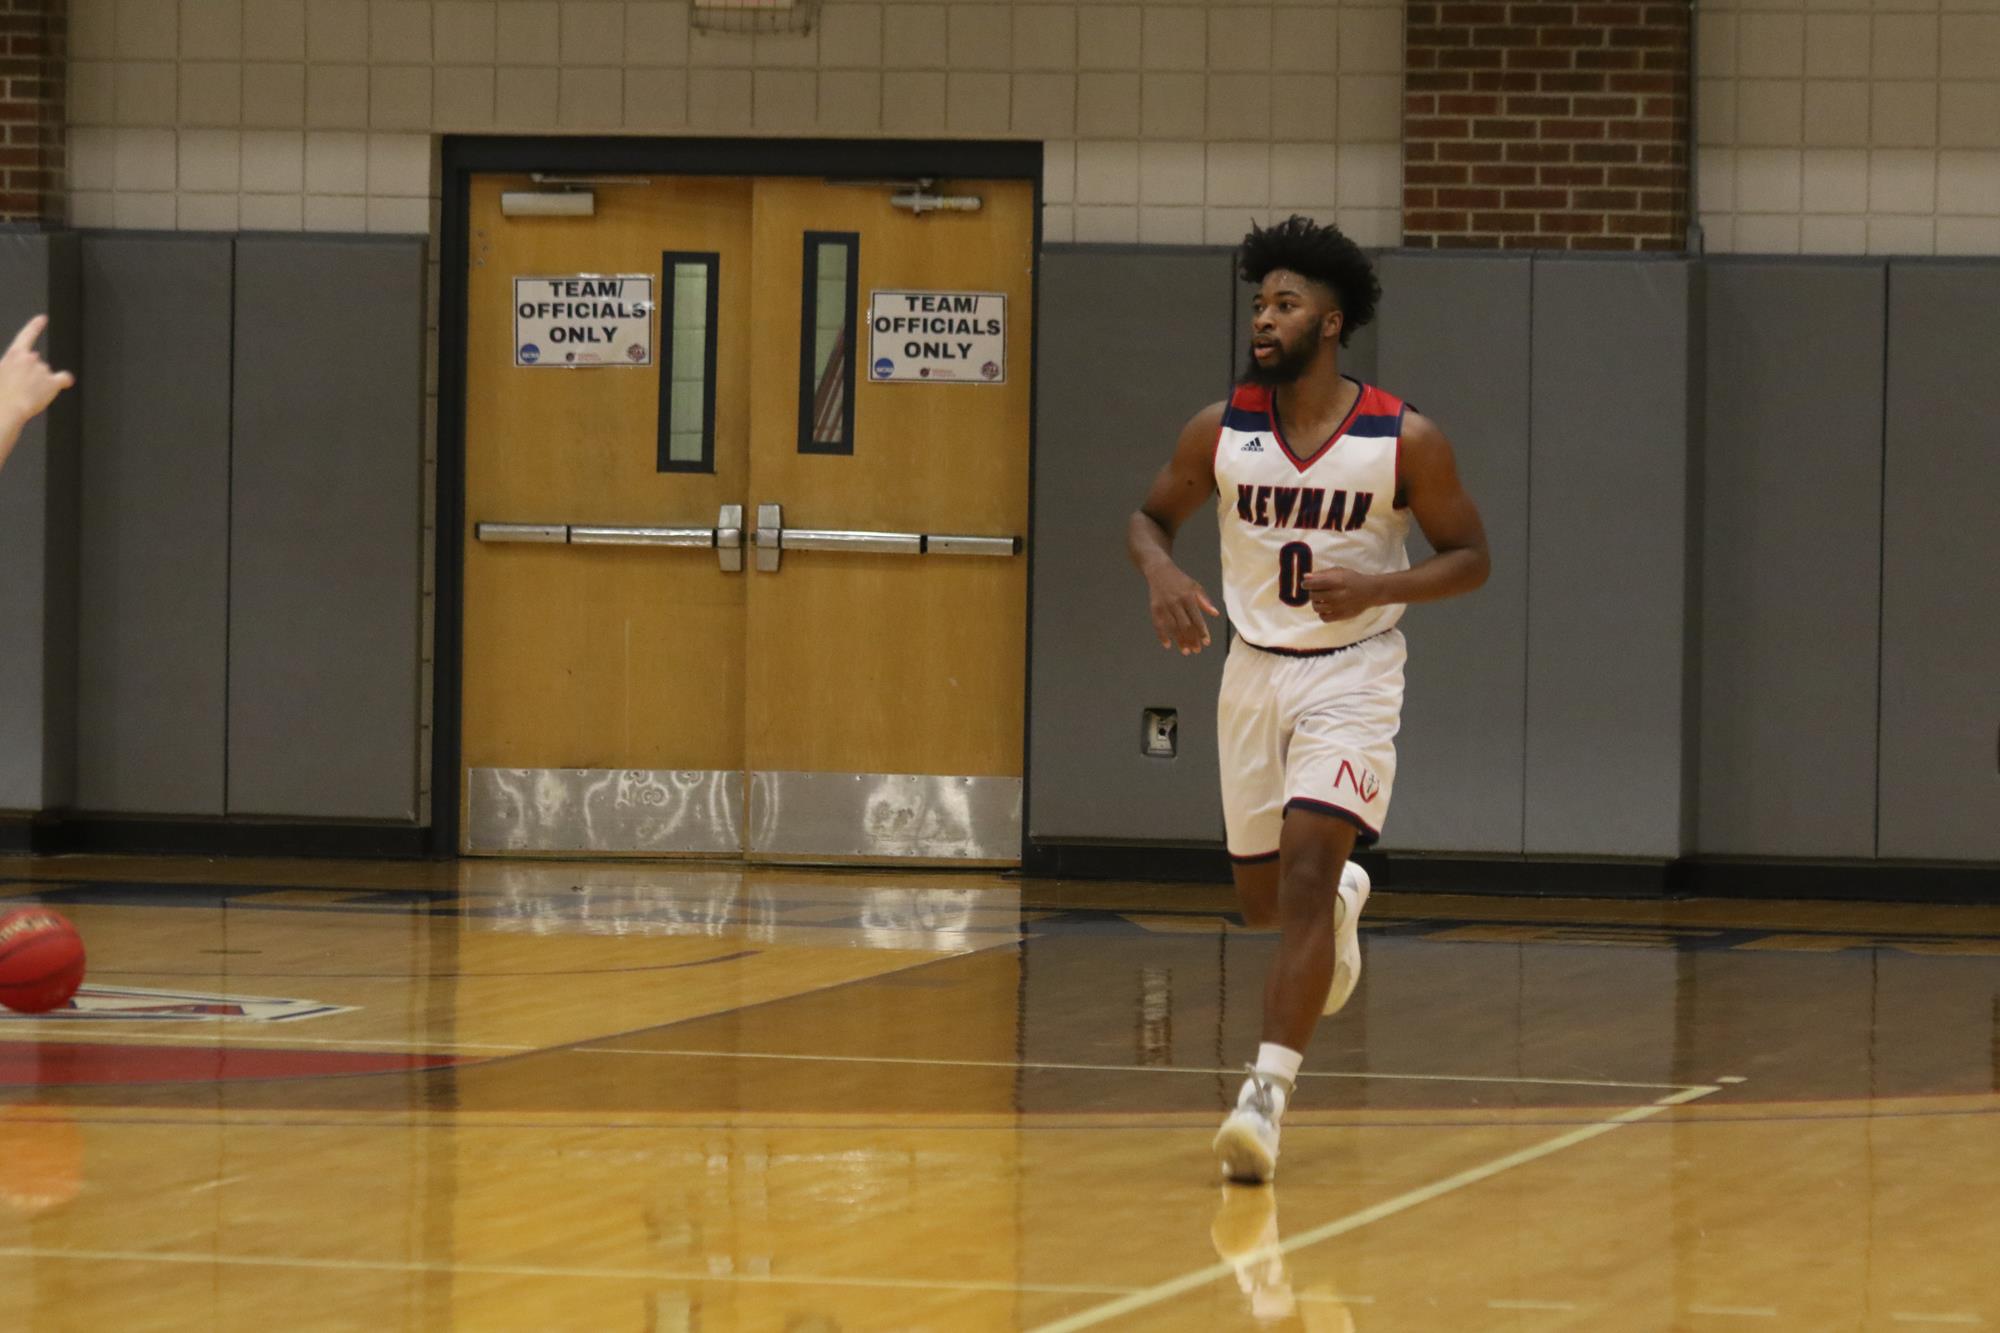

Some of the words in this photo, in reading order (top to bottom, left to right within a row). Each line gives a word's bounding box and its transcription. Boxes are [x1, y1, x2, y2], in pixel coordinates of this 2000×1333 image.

[549, 281, 624, 297] TEAM/
[519, 302, 647, 319] OFFICIALS
[905, 296, 978, 313] TEAM/
[549, 326, 617, 343] ONLY
[874, 317, 1001, 335] OFFICIALS
[904, 342, 972, 359] ONLY
[1237, 484, 1374, 532] NEWMAN
[1279, 541, 1313, 607] 0
